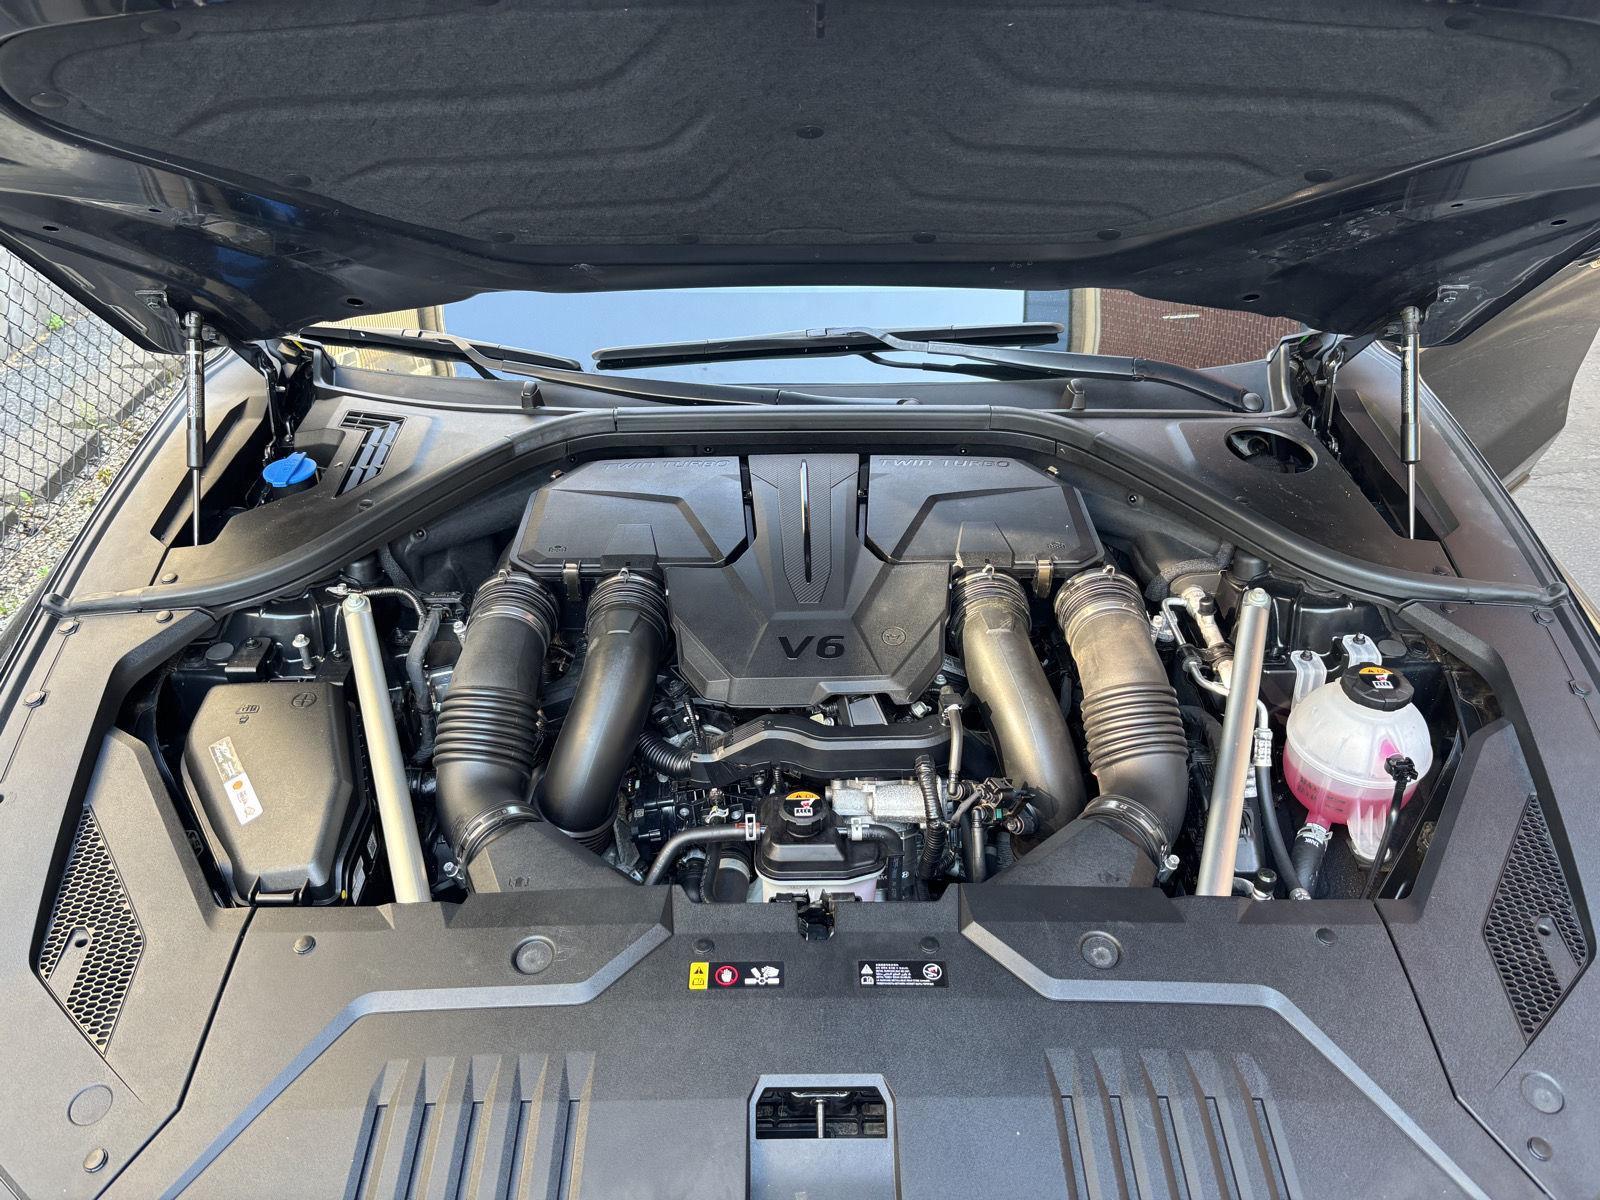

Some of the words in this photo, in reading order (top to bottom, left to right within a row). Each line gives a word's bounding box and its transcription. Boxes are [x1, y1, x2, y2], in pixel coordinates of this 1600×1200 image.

[662, 459, 731, 468] TURBO
[940, 458, 1010, 468] TURBO
[778, 635, 845, 660] V6
